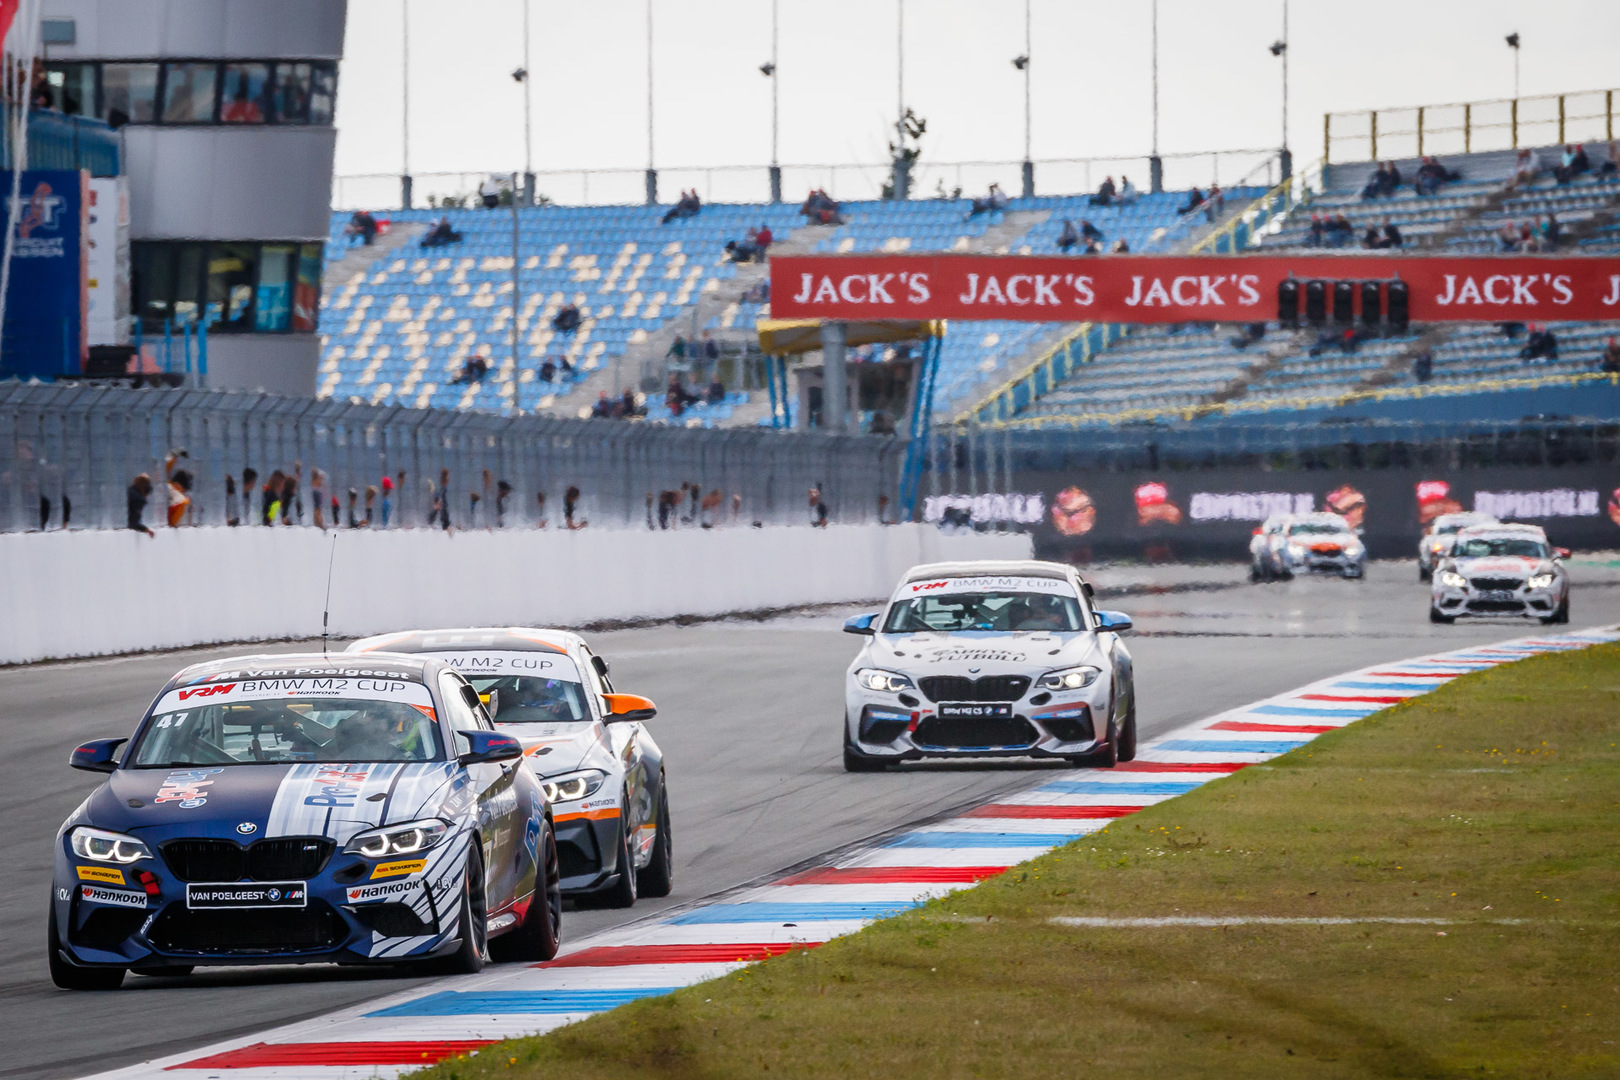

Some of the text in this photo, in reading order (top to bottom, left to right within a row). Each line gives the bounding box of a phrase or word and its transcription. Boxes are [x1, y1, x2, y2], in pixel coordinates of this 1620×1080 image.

[793, 272, 931, 304] JACK'S
[960, 273, 1096, 306] JACK'S
[1125, 274, 1260, 306] JACK'S
[1436, 273, 1573, 306] JACK'S
[953, 578, 994, 588] BMW
[998, 578, 1021, 587] M2
[1027, 579, 1058, 588] CUP
[471, 657, 503, 668] M2
[511, 658, 553, 670] CUP
[246, 669, 288, 677] Van
[294, 667, 410, 680] Poelgeest
[178, 679, 406, 701] VRM BMW M2 CUP
[156, 712, 189, 729] 47
[190, 892, 211, 900] VAN
[212, 891, 265, 900] POELGEEST
